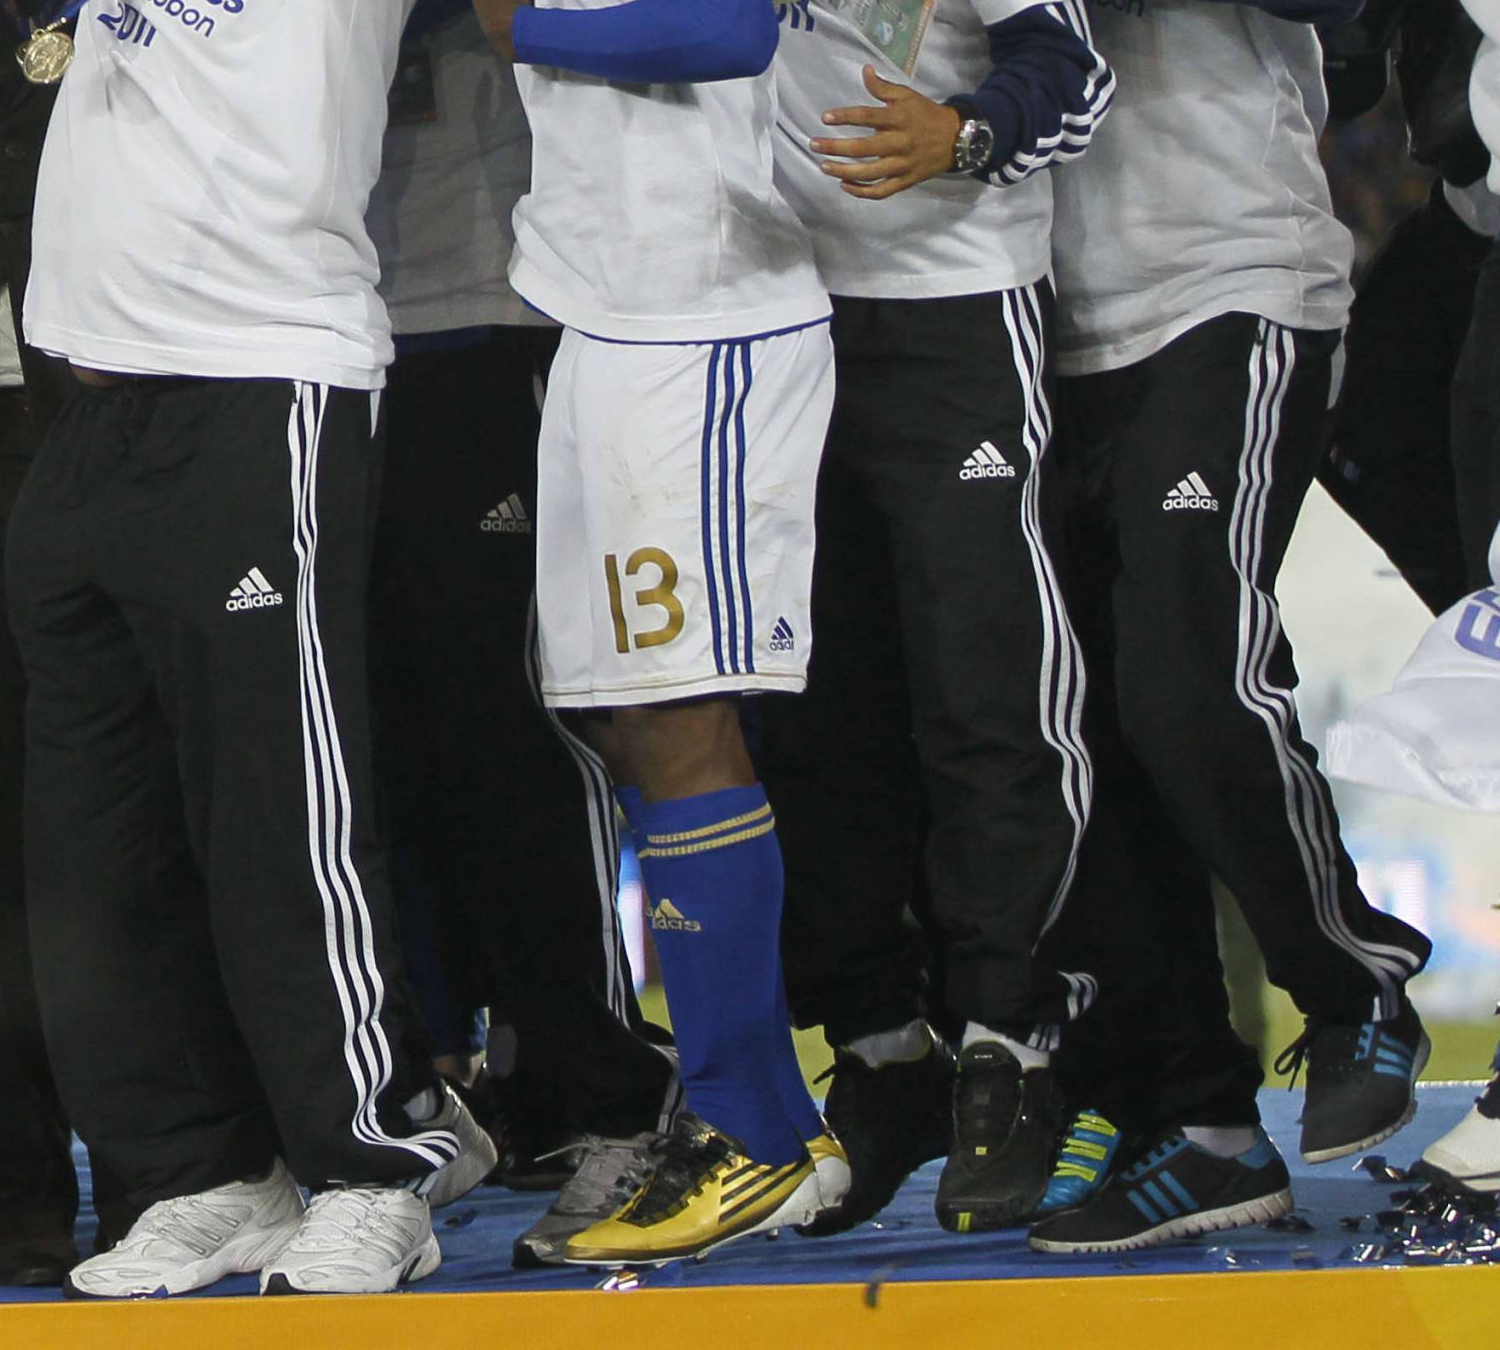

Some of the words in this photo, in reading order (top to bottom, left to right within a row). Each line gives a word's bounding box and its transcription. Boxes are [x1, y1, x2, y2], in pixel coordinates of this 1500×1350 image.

[97, 2, 157, 48] 2011
[959, 464, 1016, 481] adidas
[1162, 494, 1219, 512] adidas
[225, 593, 283, 612] adidas
[604, 546, 685, 654] 13
